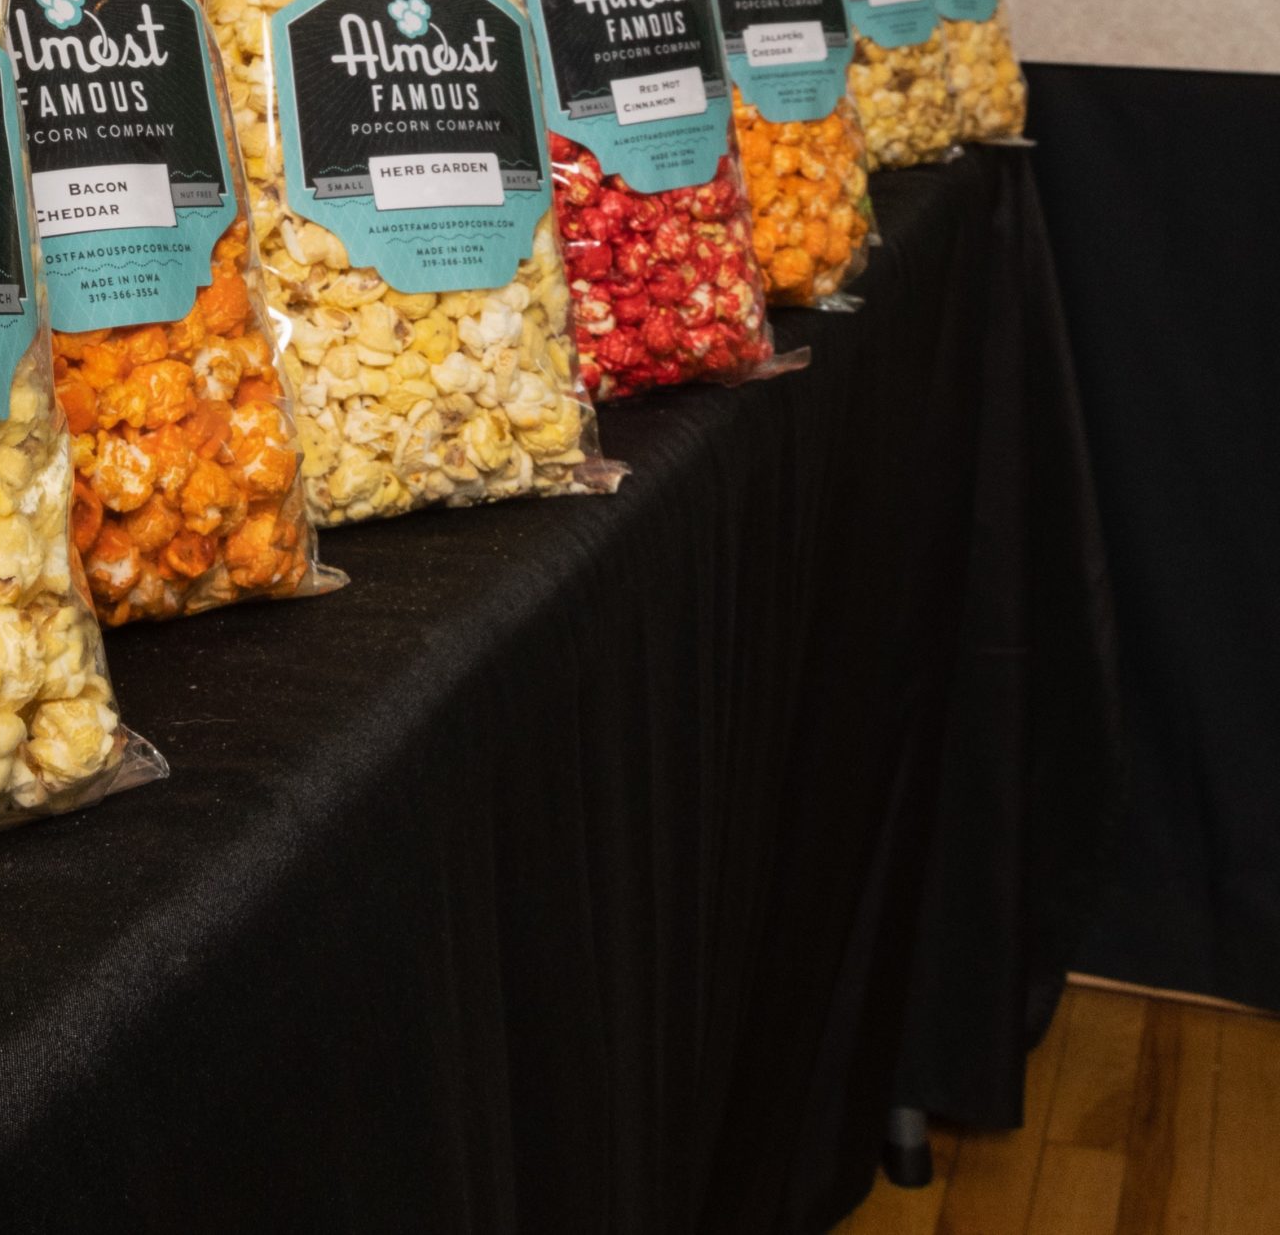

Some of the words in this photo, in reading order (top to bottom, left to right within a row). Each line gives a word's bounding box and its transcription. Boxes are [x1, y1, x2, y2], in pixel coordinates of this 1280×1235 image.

[605, 10, 687, 43] FAMOUS
[331, 13, 498, 80] Almost
[594, 45, 652, 63] POPCORN
[654, 40, 702, 55] COMPANY
[639, 83, 659, 95] RED
[662, 79, 680, 90] HOT
[372, 82, 480, 113] FAMOUS
[623, 96, 676, 113] CINNAMON
[580, 102, 610, 112] SMALL
[97, 123, 175, 138] COMPANY
[351, 120, 430, 135] POPCORN
[436, 119, 501, 132] COMPANY
[379, 164, 425, 178] HERB
[431, 162, 489, 174] GARDEN
[327, 181, 365, 192] SMALL
[506, 175, 533, 185] BATCH
[68, 181, 128, 196] BACON
[368, 219, 515, 236] ALMOSTFAMOUSPOPCORN.COM
[45, 243, 191, 265] OSTFAMOUSPOPCORN.COM
[416, 246, 444, 256] MADE
[447, 246, 458, 254] IN
[461, 244, 485, 253] IOWA
[80, 278, 115, 291] MADE
[119, 276, 130, 285] IN
[132, 273, 161, 284] IOWA
[88, 286, 160, 304] 319-366-3554
